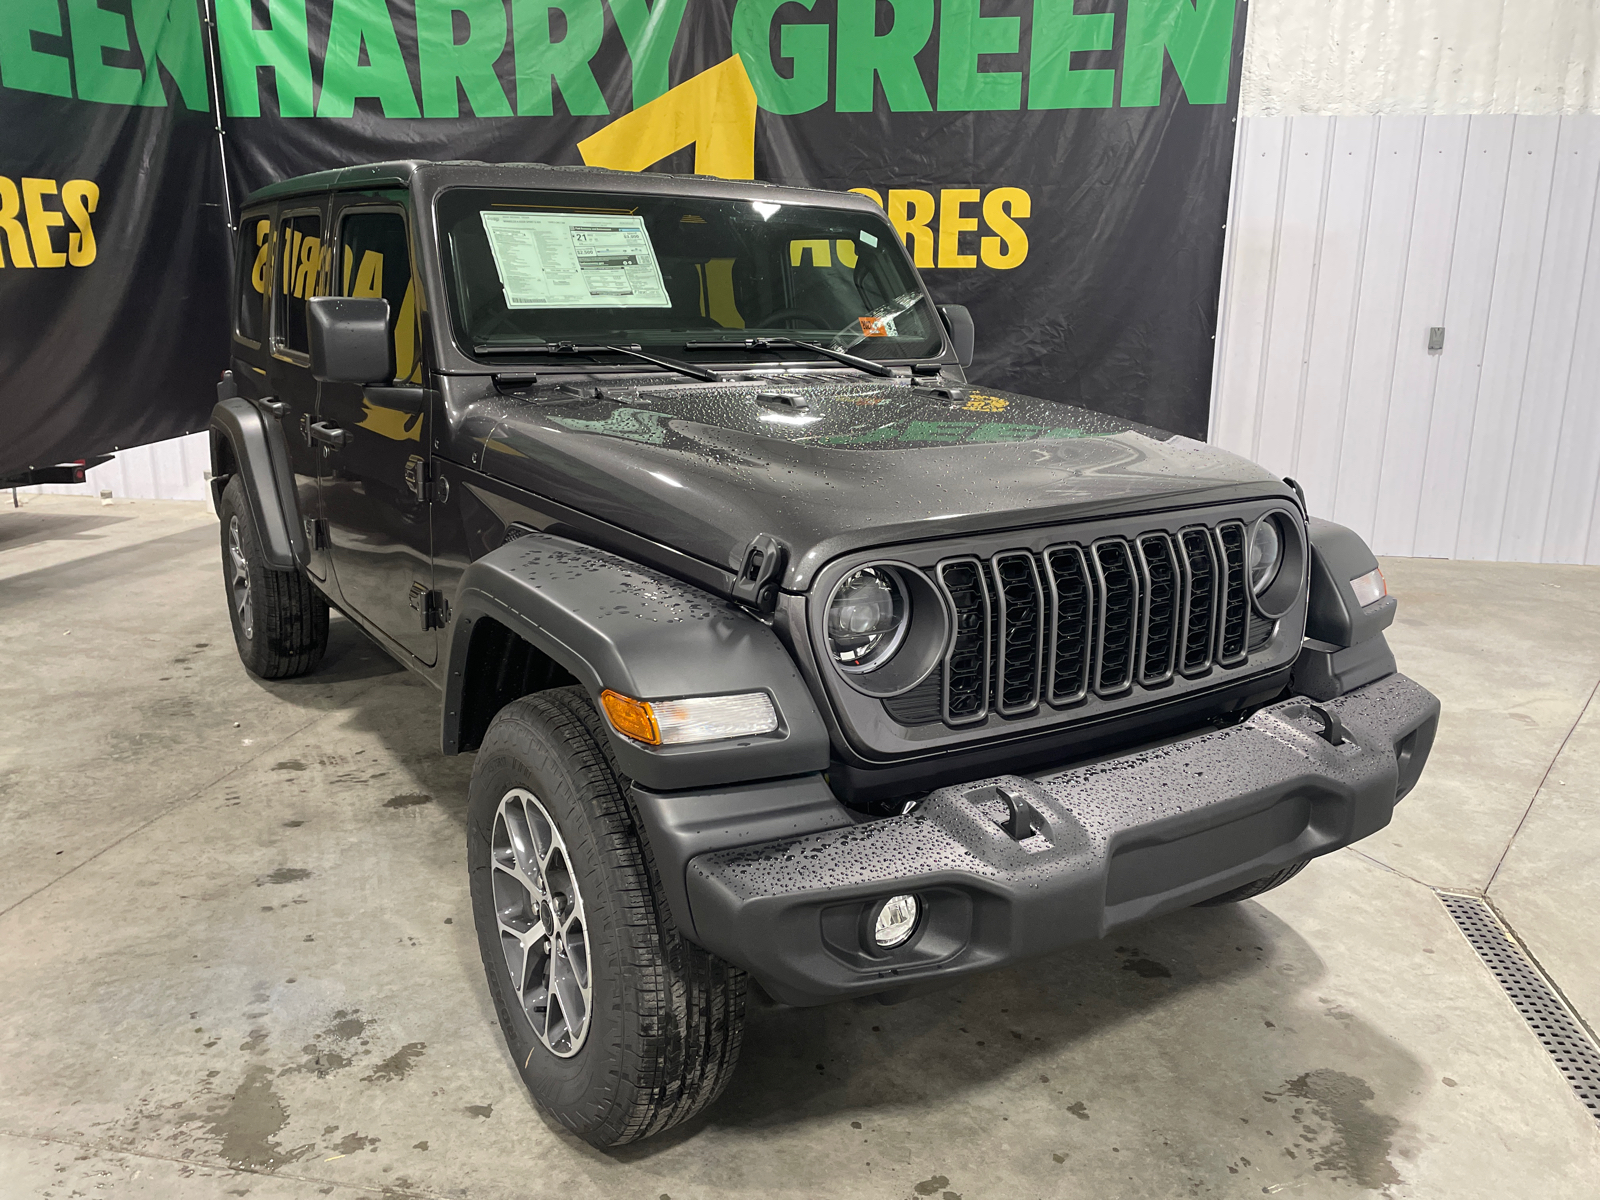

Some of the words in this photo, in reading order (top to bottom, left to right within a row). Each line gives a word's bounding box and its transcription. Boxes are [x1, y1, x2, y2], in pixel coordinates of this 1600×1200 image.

[215, 0, 697, 118] HARRY
[731, 0, 1234, 115] GREEN
[576, 233, 587, 241] 21
